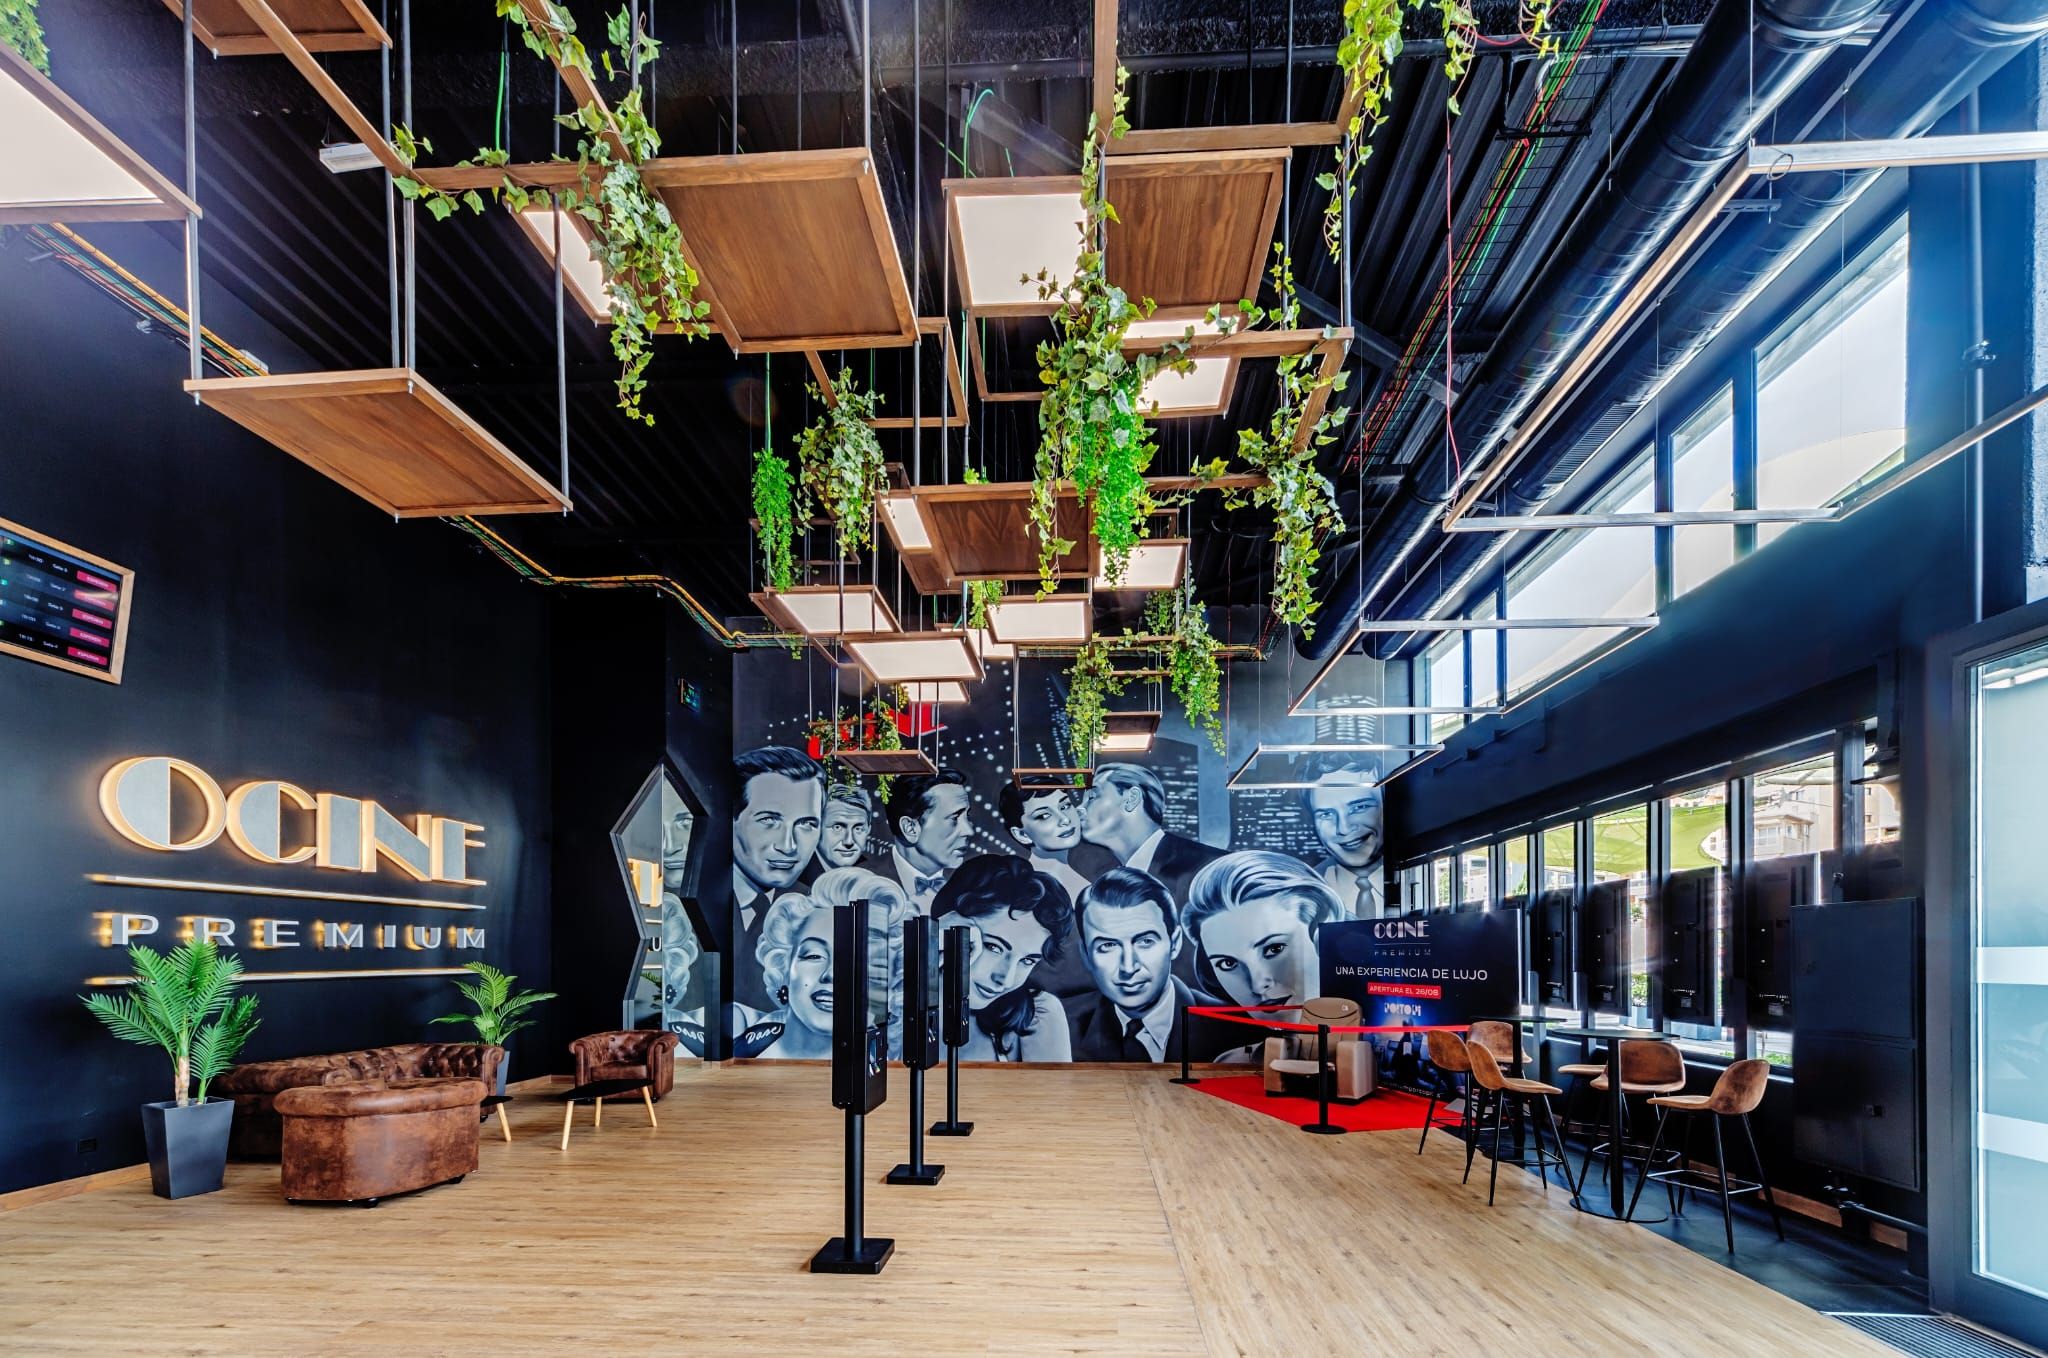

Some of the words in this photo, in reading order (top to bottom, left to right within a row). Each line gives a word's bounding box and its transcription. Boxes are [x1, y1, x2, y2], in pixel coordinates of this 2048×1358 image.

[99, 756, 488, 885] OCINE
[110, 912, 486, 950] PREMIUM
[1374, 920, 1430, 939] OCINE
[1335, 966, 1355, 976] UNA
[1357, 967, 1429, 979] EXPERIENCIA
[1432, 969, 1450, 979] DE
[1452, 969, 1488, 981] LUJO
[1369, 985, 1404, 994] APERTURA
[1405, 987, 1414, 995] EL
